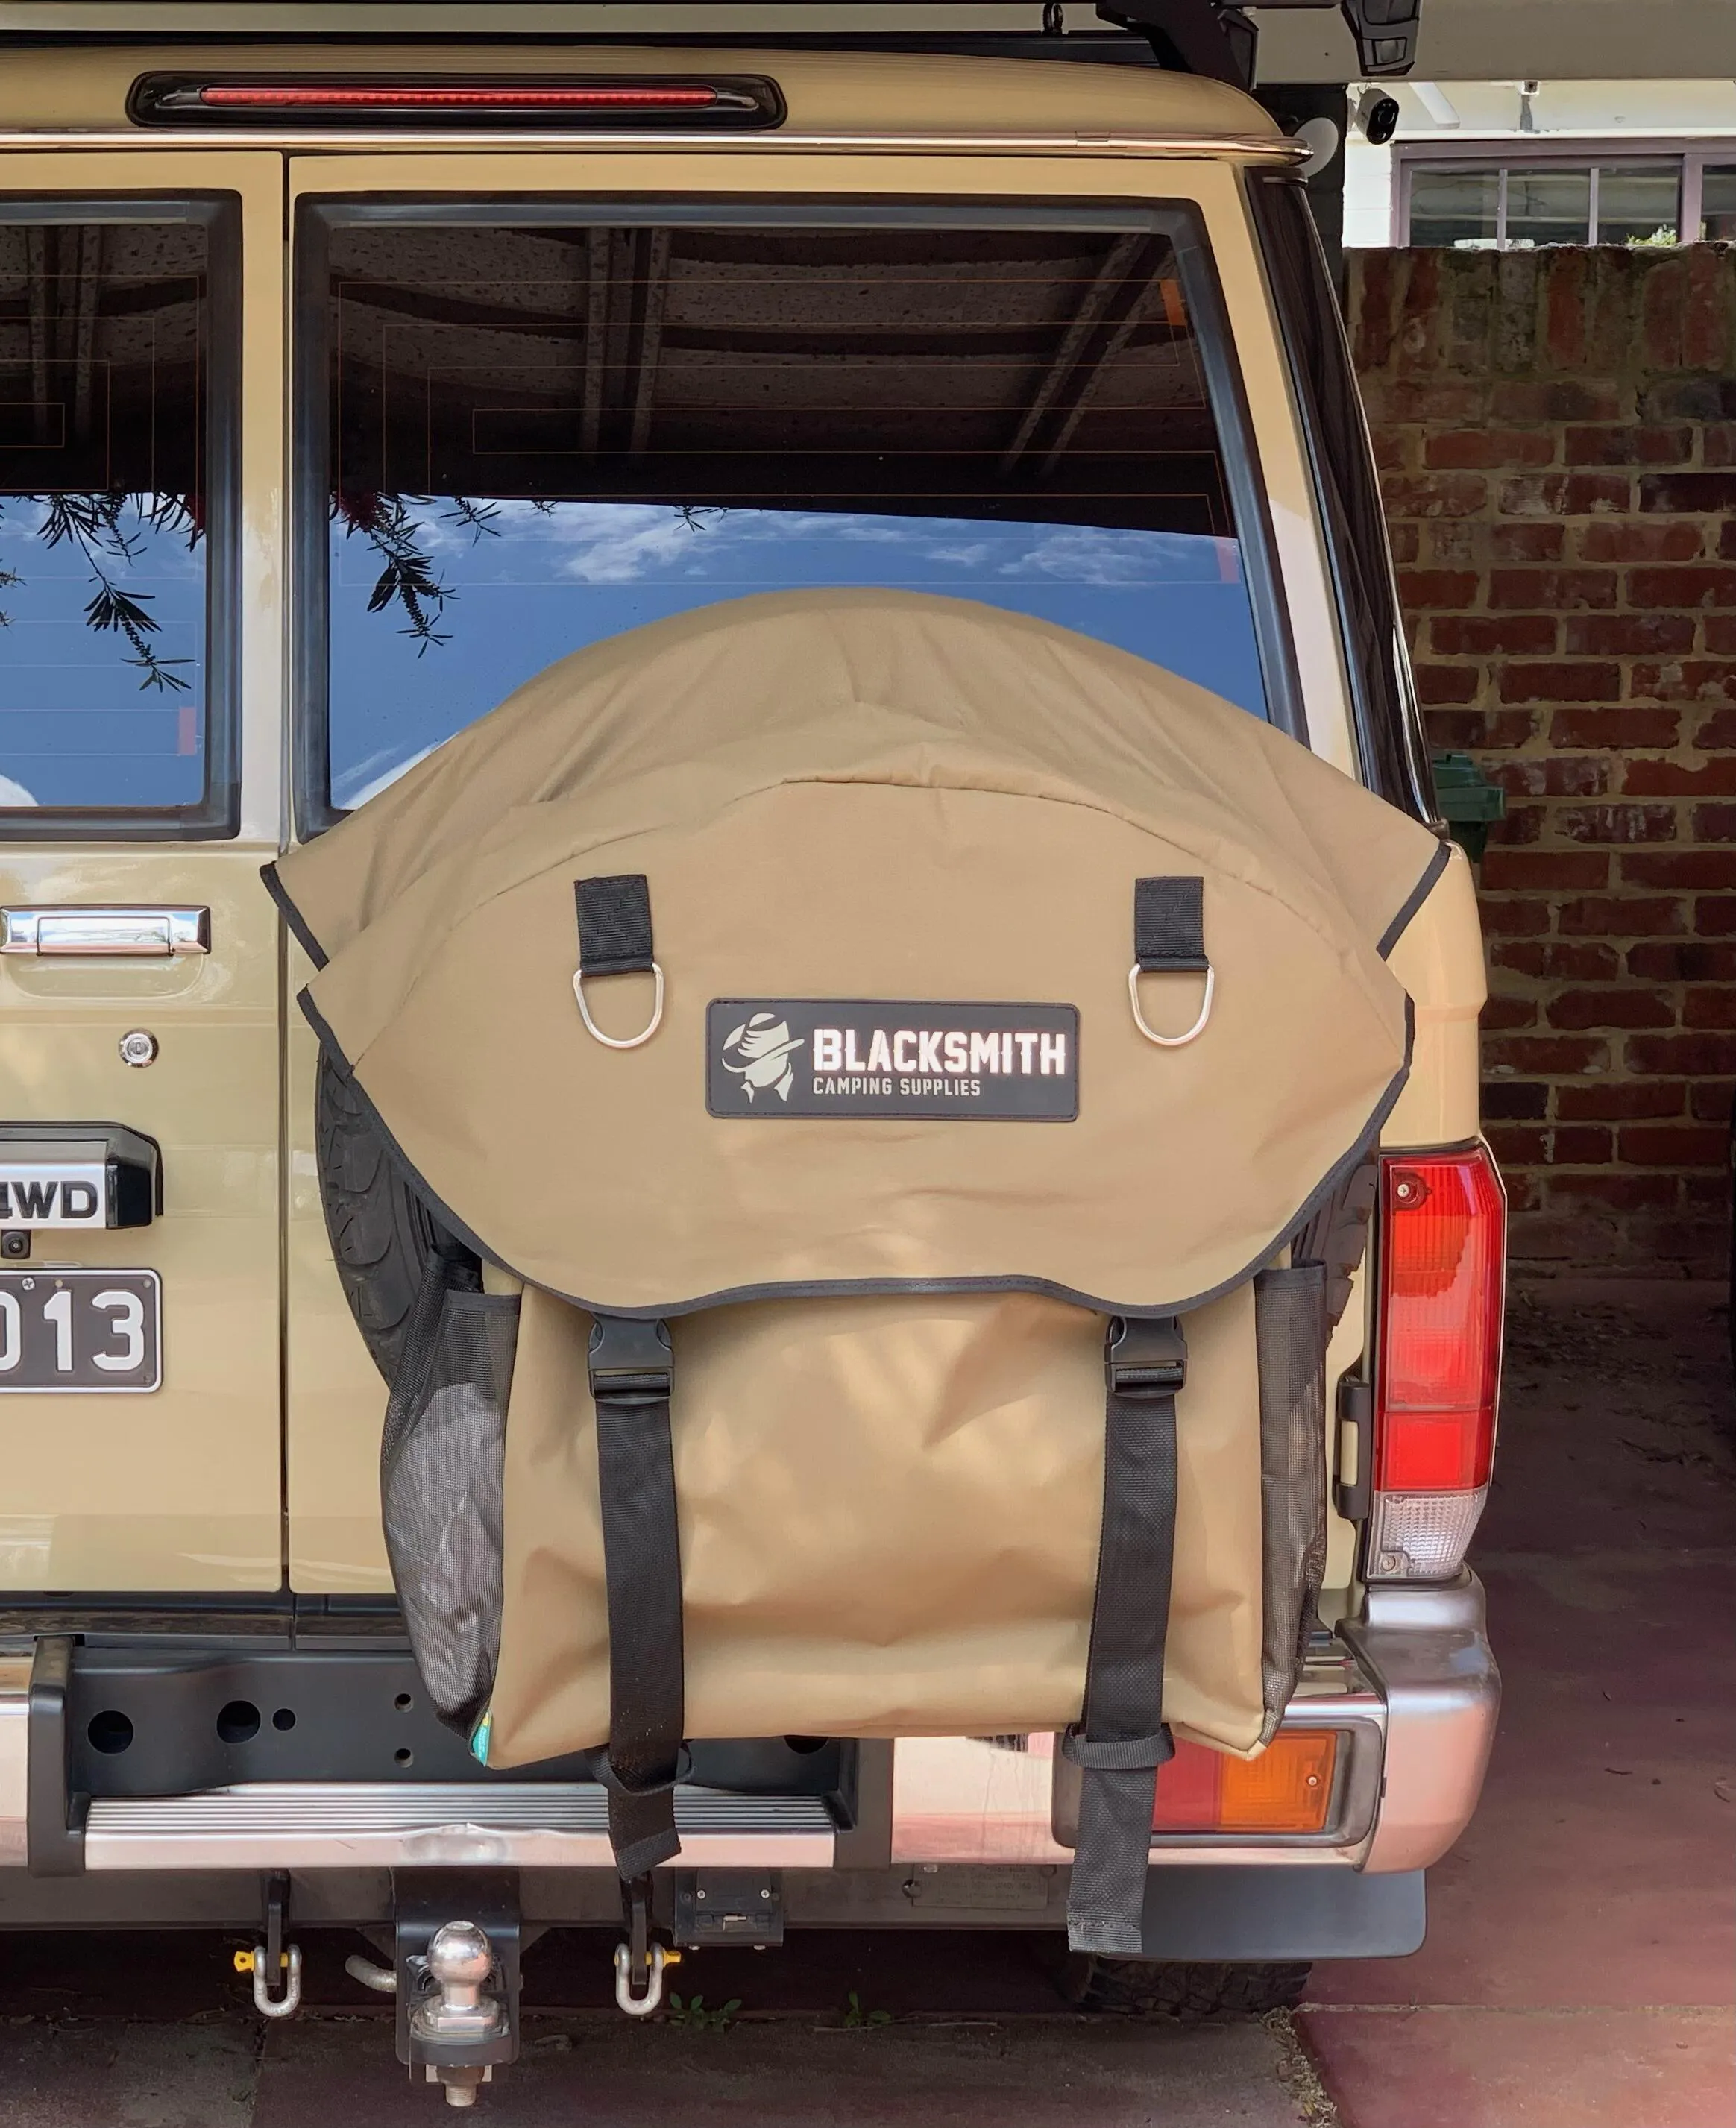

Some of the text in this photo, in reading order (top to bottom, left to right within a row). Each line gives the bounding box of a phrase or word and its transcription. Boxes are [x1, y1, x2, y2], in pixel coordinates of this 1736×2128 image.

[813, 1028, 1066, 1074] BLACKSMITH
[813, 1077, 981, 1096] CAMPING SUPPLIES
